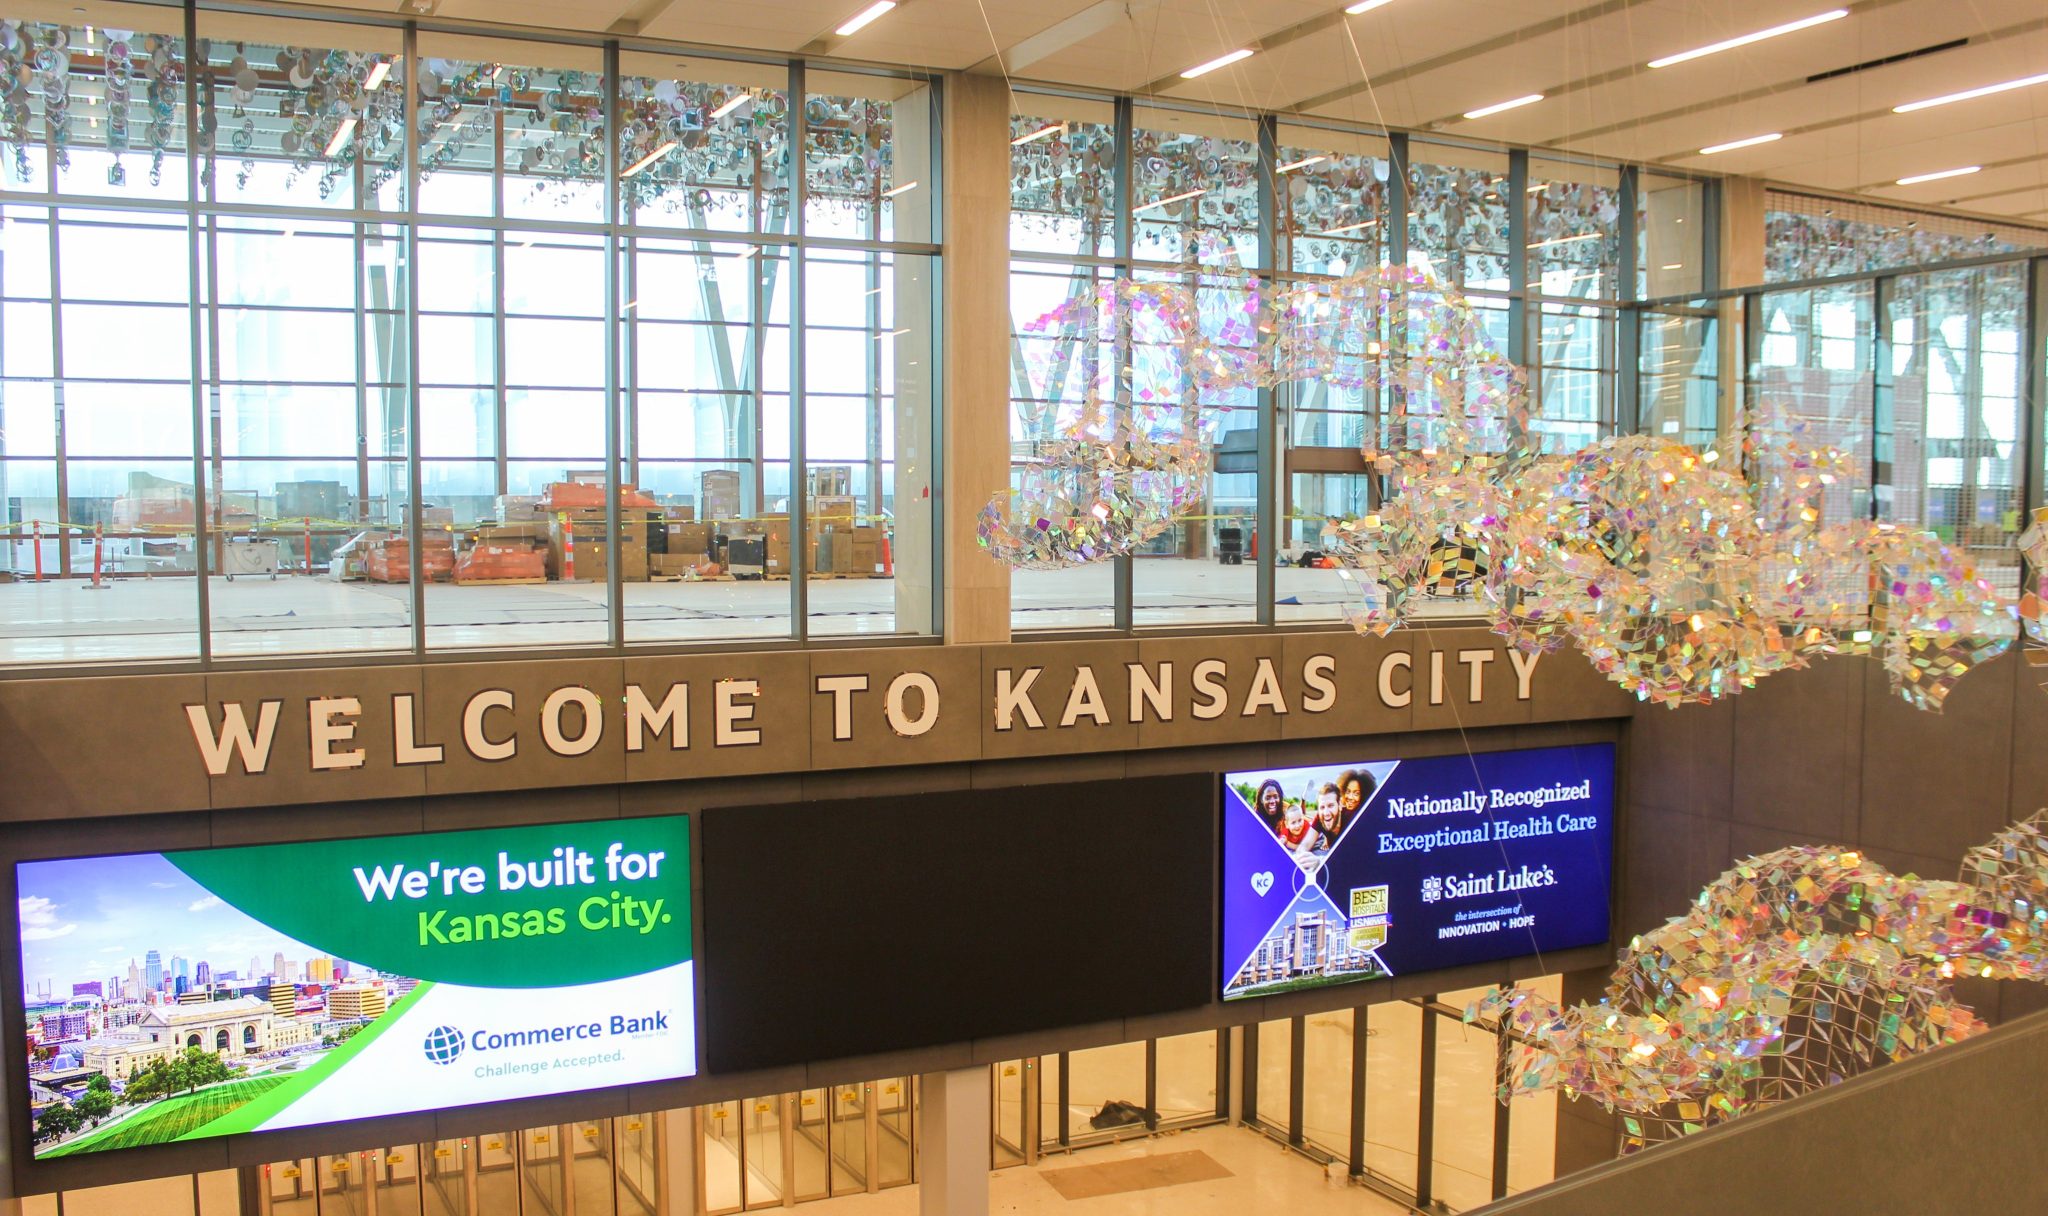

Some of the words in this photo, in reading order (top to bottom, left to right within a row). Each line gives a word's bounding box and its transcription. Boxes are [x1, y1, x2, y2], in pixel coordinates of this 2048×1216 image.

[183, 677, 761, 777] WELCOME
[816, 671, 940, 741] TO
[994, 653, 1338, 731] KANSAS
[1377, 648, 1544, 709] CITY
[1387, 790, 1488, 819] Nationally
[1490, 779, 1591, 808] Recognized
[1378, 822, 1490, 853] Exceptional
[1493, 815, 1553, 841] Health
[1556, 814, 1597, 833] Care
[353, 861, 486, 903] We're
[498, 846, 596, 891] built
[604, 842, 665, 882] for
[1256, 878, 1269, 888] KC
[1444, 873, 1494, 899] Saint
[1353, 889, 1386, 906] BEST
[1353, 904, 1386, 916] HOSPITALS
[1455, 909, 1467, 921] the
[1468, 905, 1512, 919] intersection
[1513, 903, 1522, 915] of
[418, 905, 567, 946] Kansas
[578, 891, 672, 935] City.
[1438, 920, 1500, 939] INNOVATION
[1509, 915, 1535, 929] HOPE
[471, 1022, 602, 1051] Commerce
[610, 1010, 668, 1036] Bank
[474, 1060, 549, 1079] Challenge
[552, 1049, 625, 1070] Accepted.
